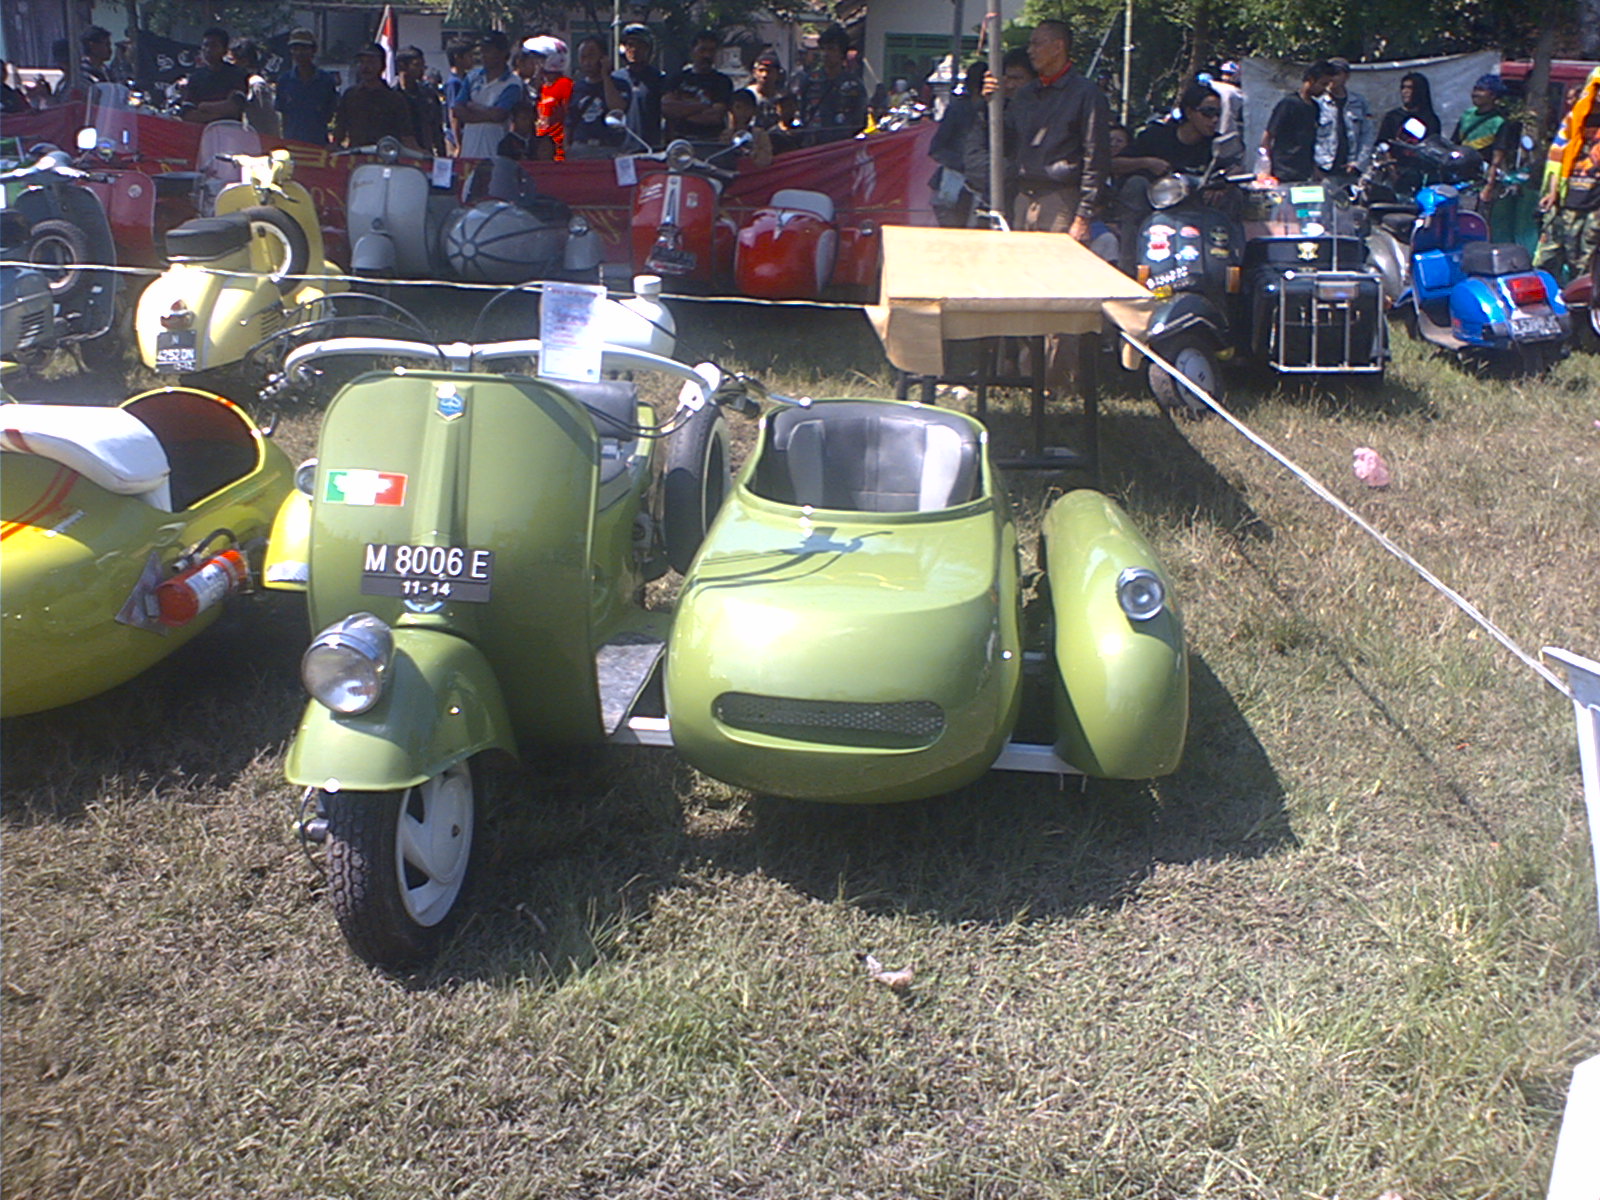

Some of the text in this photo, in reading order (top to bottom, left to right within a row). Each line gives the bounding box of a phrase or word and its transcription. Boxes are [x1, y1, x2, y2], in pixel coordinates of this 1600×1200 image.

[364, 544, 490, 579] M 8006 E
[402, 580, 451, 597] 11-14
